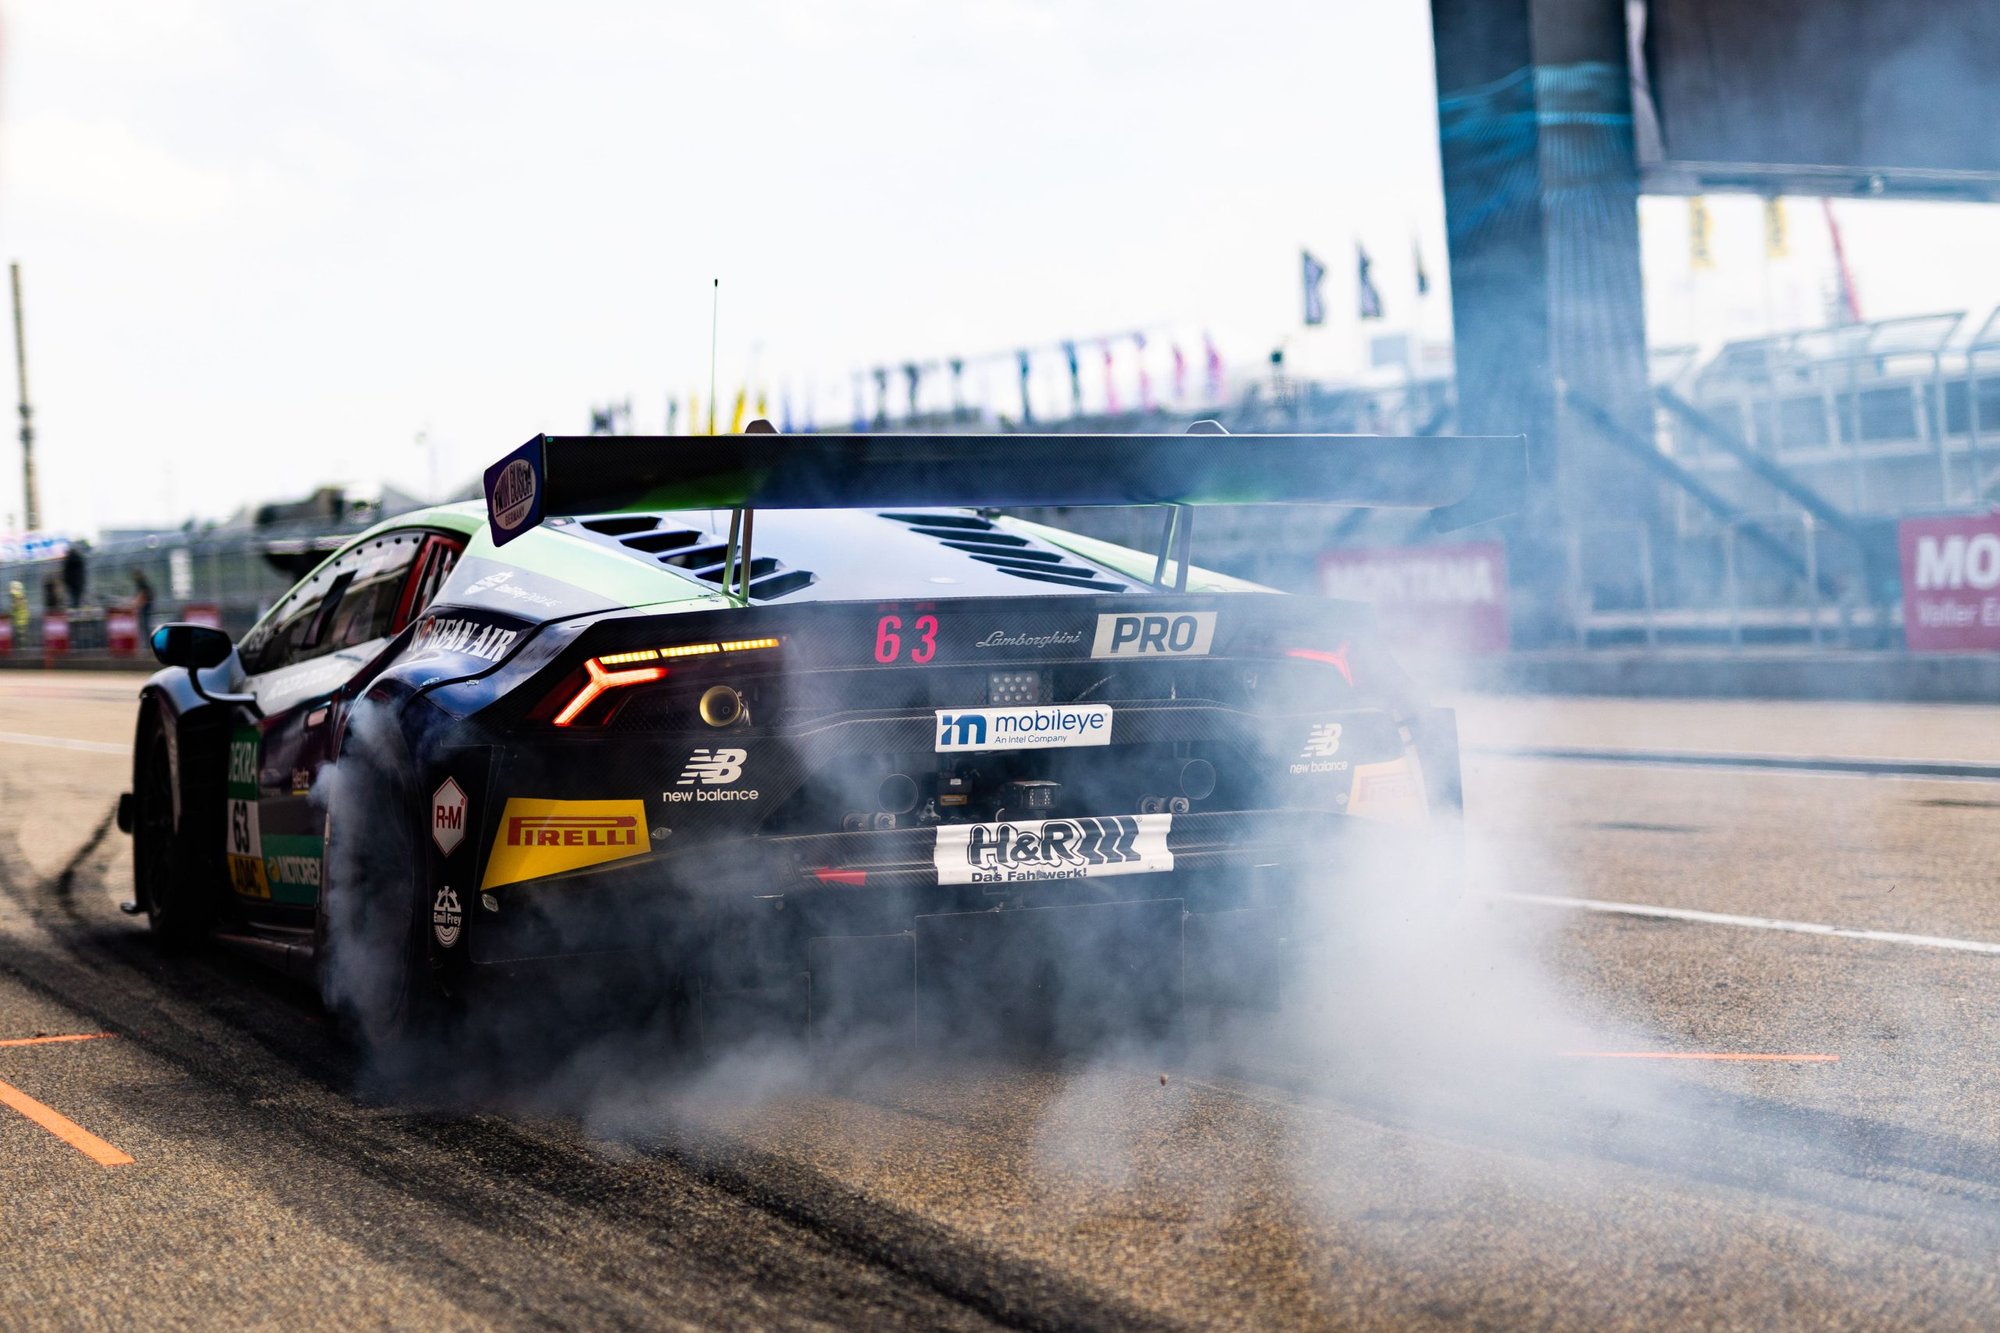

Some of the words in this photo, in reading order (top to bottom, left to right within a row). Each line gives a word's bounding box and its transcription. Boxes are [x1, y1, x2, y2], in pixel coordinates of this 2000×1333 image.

[407, 615, 480, 653] KOREAN
[461, 624, 518, 662] AIR
[975, 630, 1082, 649] Lamborghini
[1110, 616, 1199, 653] PRO
[995, 709, 1104, 734] mobileye
[995, 736, 1007, 744] An
[1008, 735, 1026, 744] Intel
[1028, 734, 1067, 744] Company
[1290, 763, 1311, 775] new
[1311, 760, 1348, 773] balance
[662, 790, 692, 802] new
[696, 788, 759, 802] balance
[233, 801, 251, 853] 63
[436, 805, 462, 830] R-M
[507, 815, 637, 846] PIRELLI
[967, 820, 1085, 869] H&R
[972, 871, 1003, 883] Das
[433, 911, 447, 925] Emil
[447, 913, 462, 928] Frey
